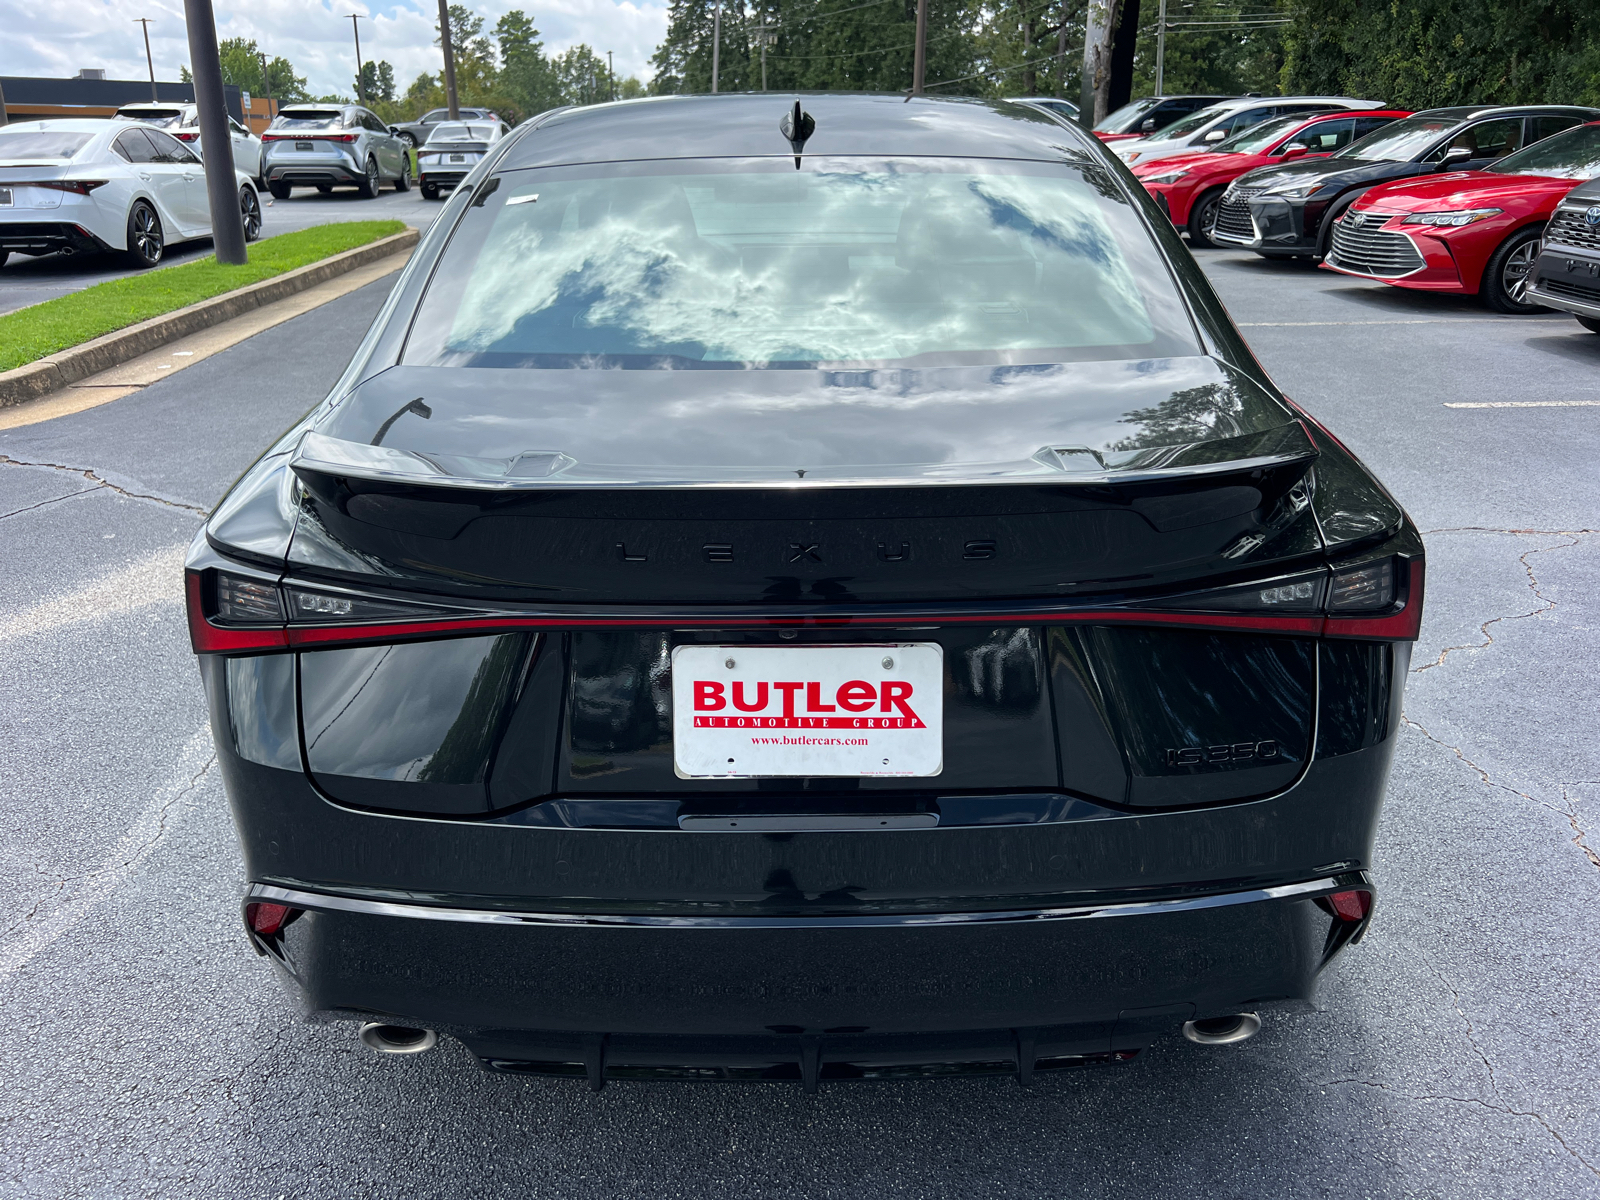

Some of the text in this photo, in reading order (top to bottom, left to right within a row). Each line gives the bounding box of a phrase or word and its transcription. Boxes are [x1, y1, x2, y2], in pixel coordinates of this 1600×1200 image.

[615, 540, 997, 563] LEXUS
[694, 717, 918, 728] AUTOMOTIVE GROUP
[751, 735, 869, 747] www.butlercars.com
[1166, 739, 1281, 767] IS 350
